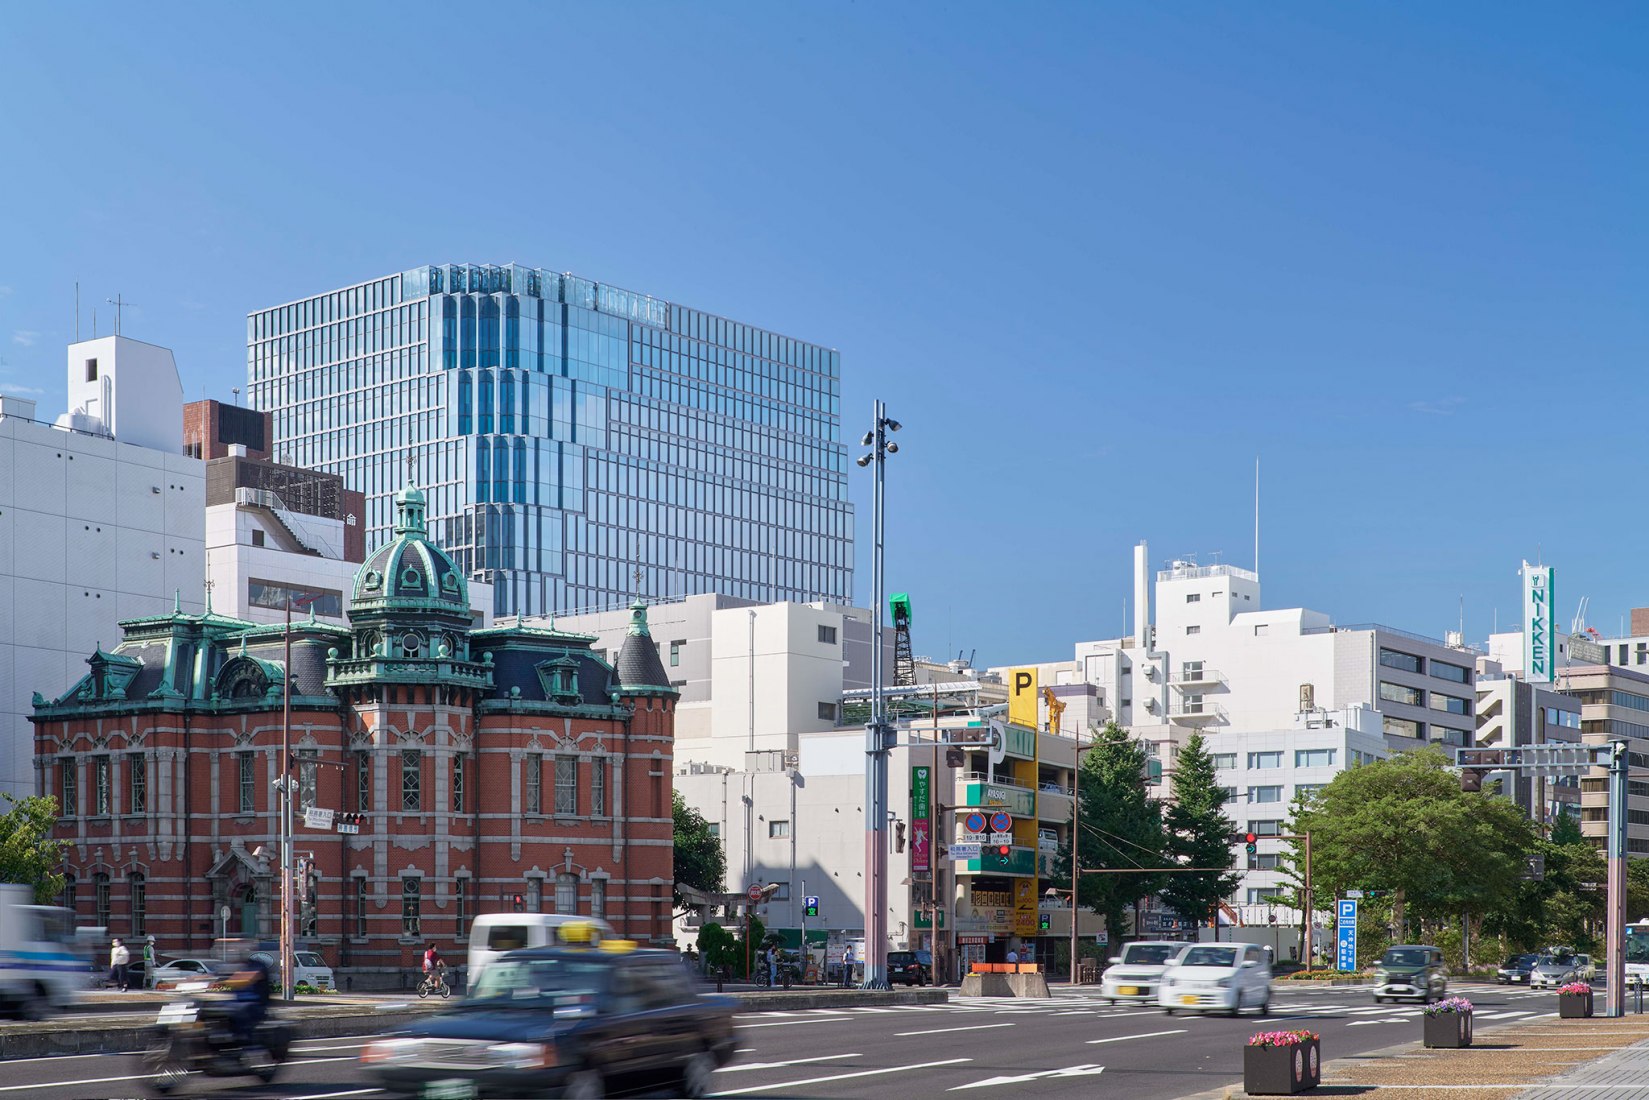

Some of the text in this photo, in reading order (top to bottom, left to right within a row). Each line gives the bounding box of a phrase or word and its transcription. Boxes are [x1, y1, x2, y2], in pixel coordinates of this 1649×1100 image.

[1532, 589, 1544, 674] NIKKEN
[1015, 672, 1032, 696] P
[918, 781, 926, 817] やすだ歯科
[808, 898, 816, 907] P
[1342, 904, 1353, 916] P
